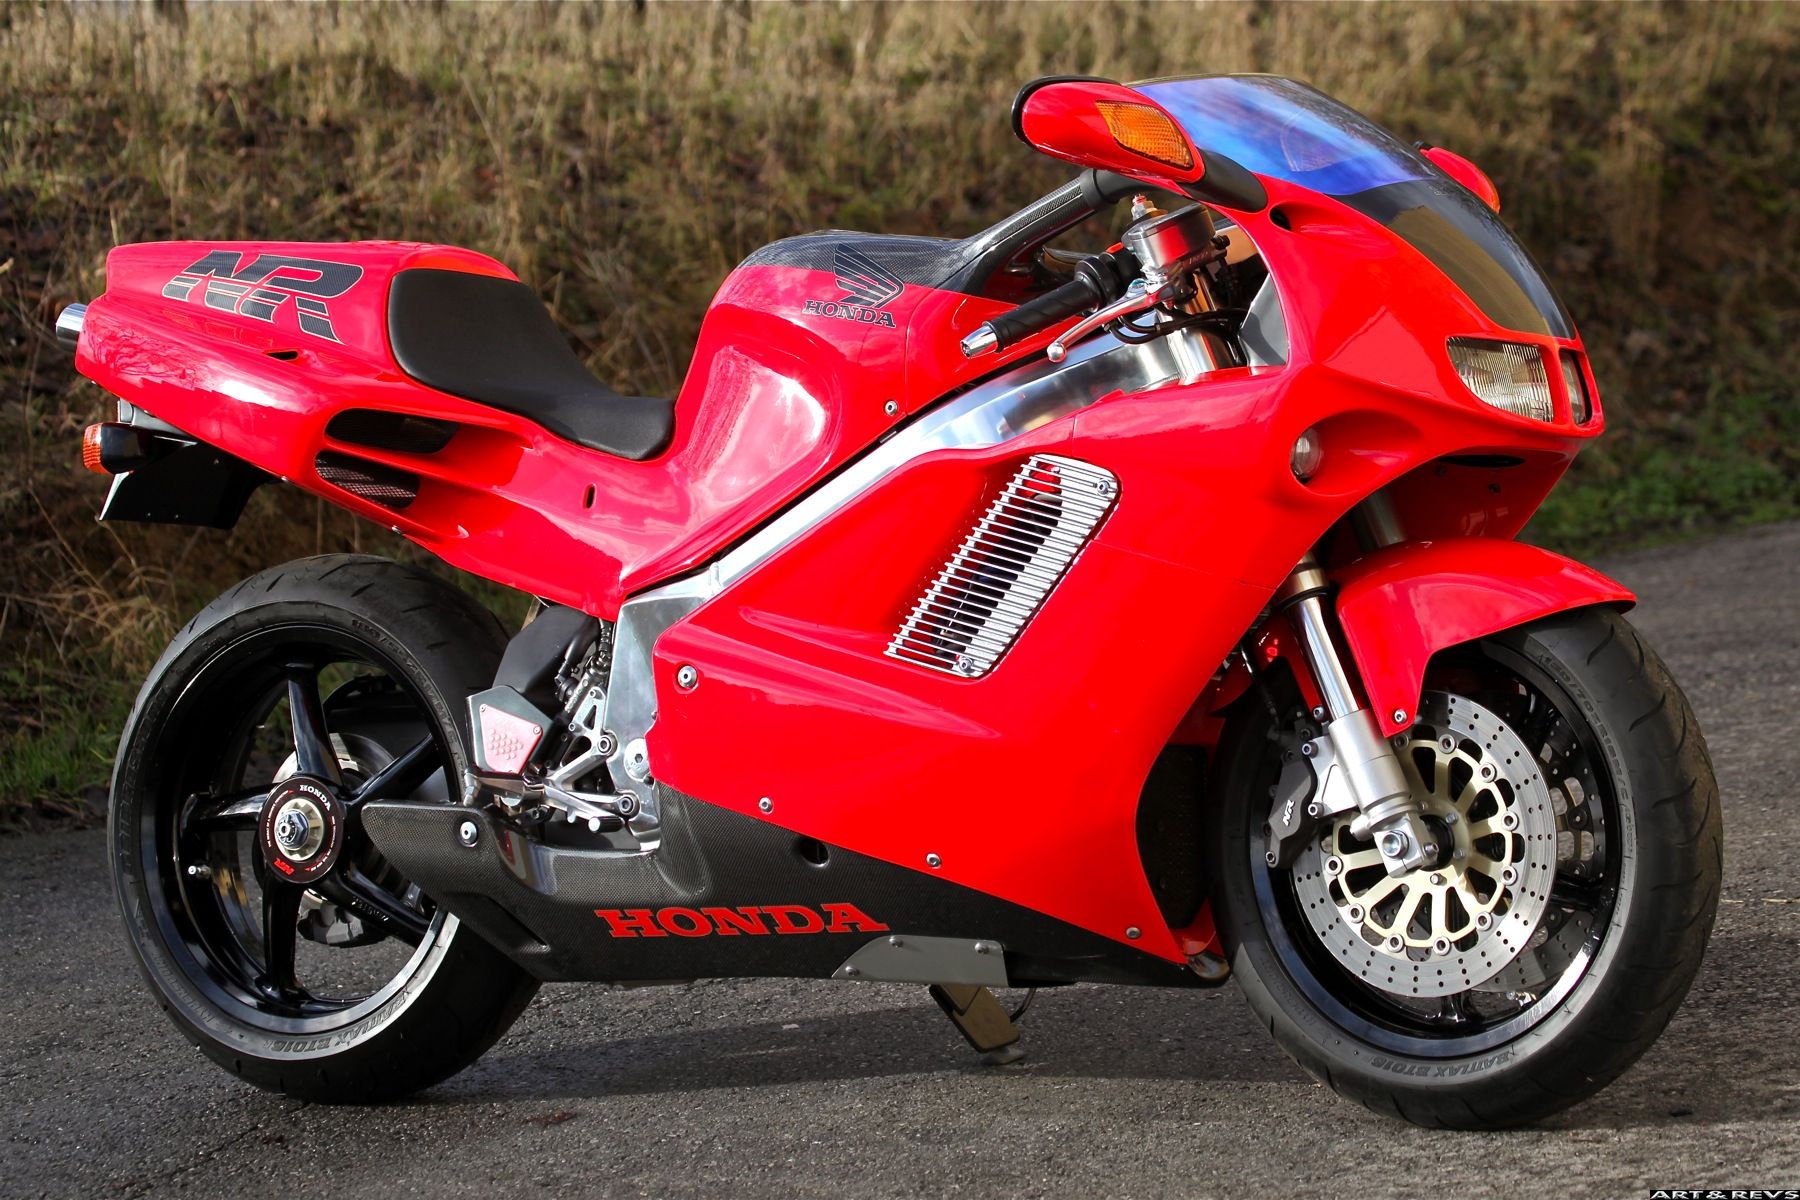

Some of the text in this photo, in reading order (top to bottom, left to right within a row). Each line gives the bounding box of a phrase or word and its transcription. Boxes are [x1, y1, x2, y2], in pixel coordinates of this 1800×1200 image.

[802, 300, 896, 328] HONDA
[299, 784, 331, 811] HONDA
[1282, 799, 1295, 826] NR
[594, 902, 890, 937] HONDA
[1433, 1051, 1511, 1078] BATTLAX
